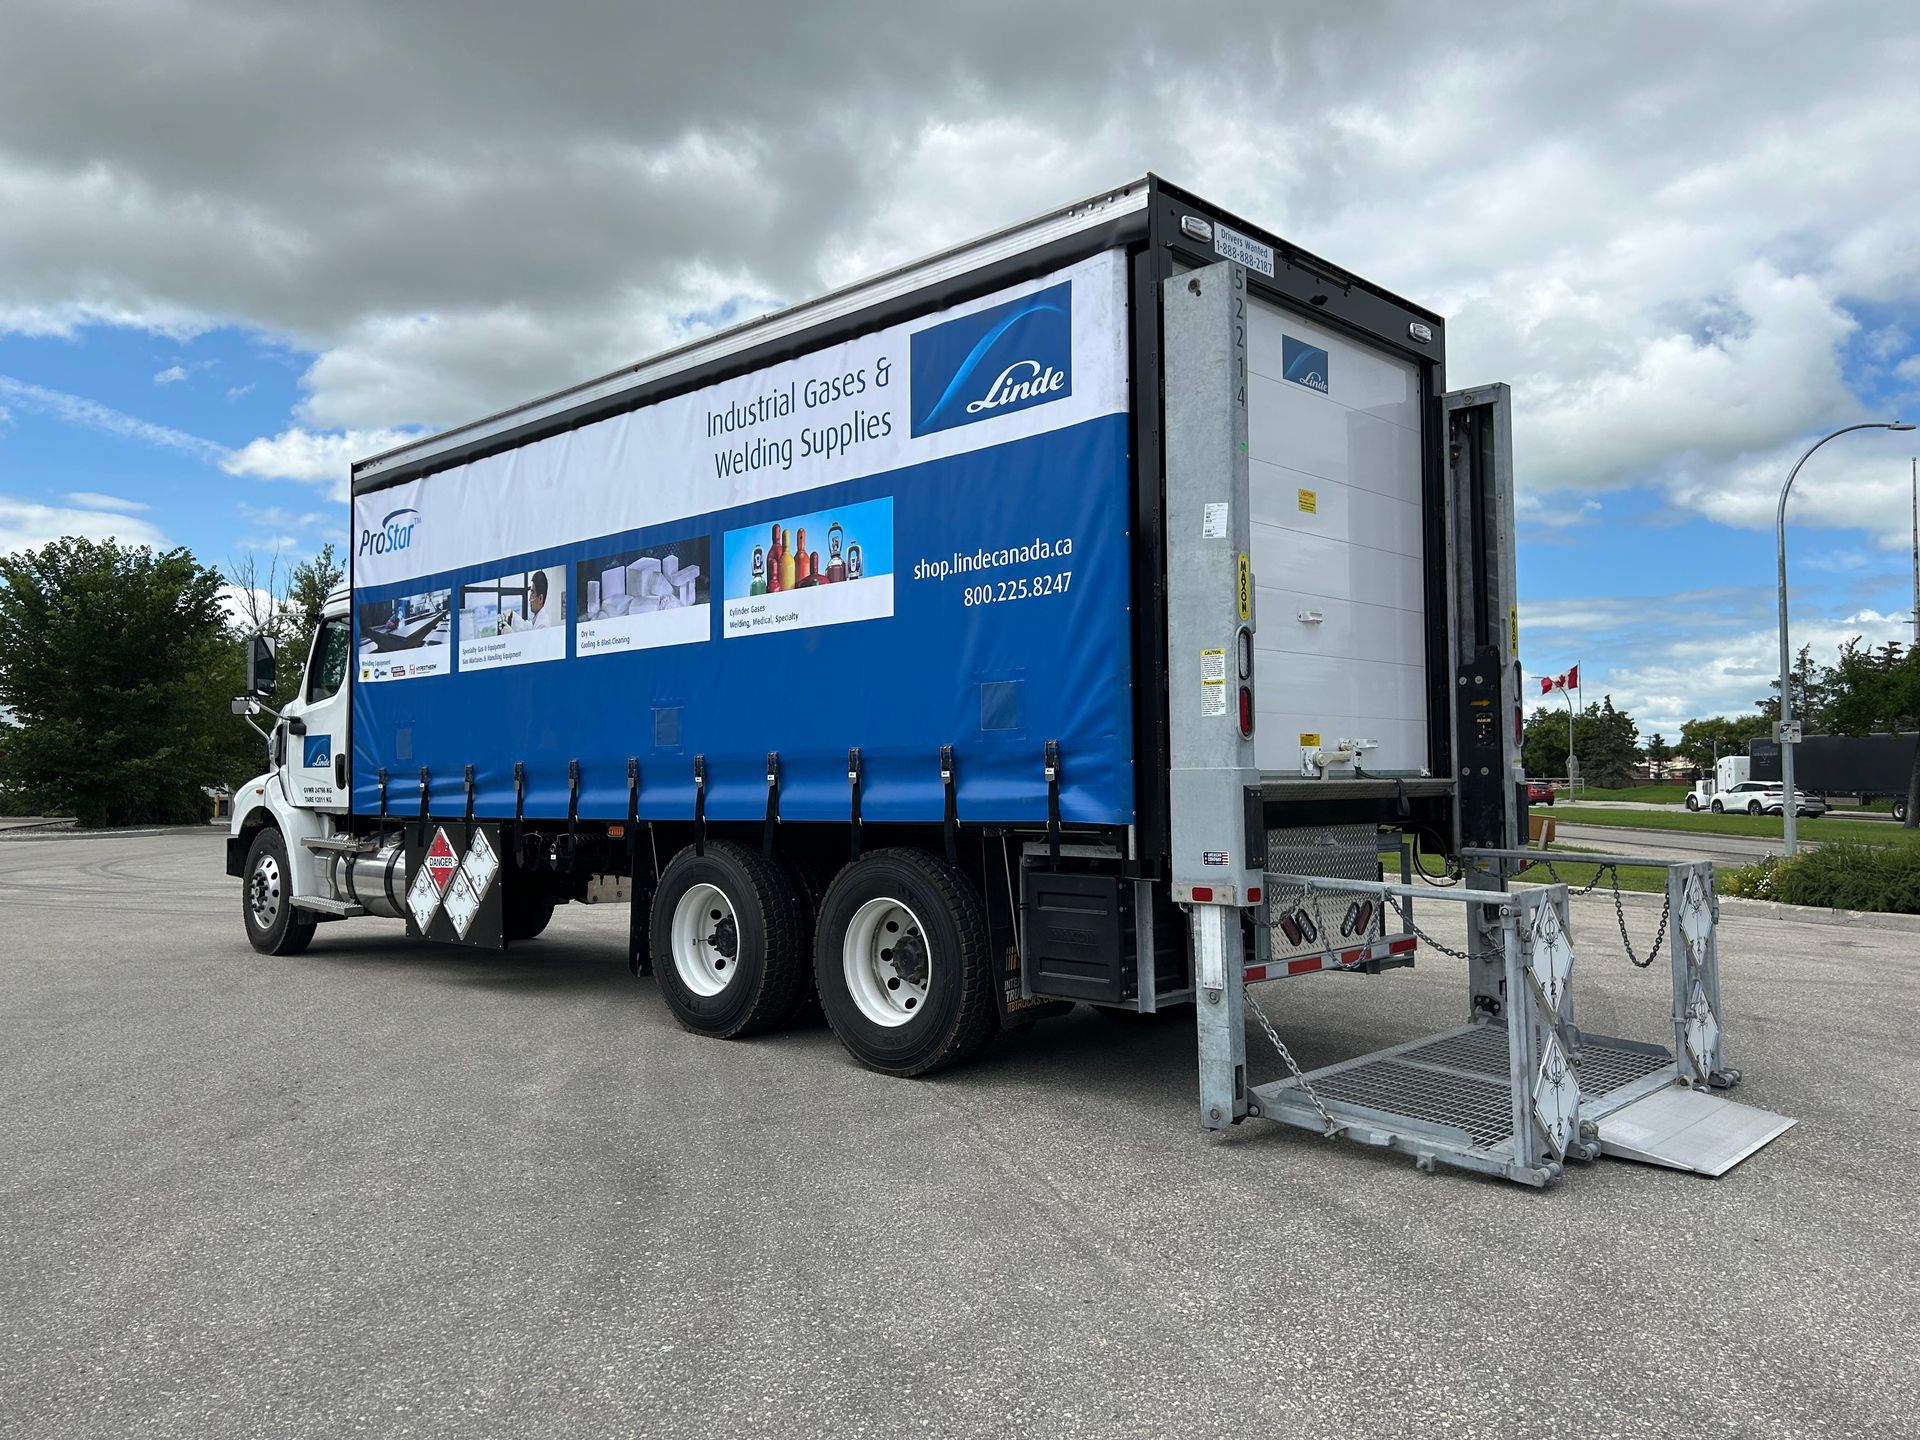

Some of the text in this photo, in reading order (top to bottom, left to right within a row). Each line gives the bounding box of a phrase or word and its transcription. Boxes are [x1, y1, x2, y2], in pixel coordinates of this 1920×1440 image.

[1216, 240, 1272, 274] 1-888-888-2187
[1221, 229, 1268, 259] Drivers Wanted
[707, 356, 892, 437] Industrial Gases &
[966, 360, 1065, 413] Linde
[1300, 371, 1328, 392] Linde
[715, 410, 892, 479] Welding Supplies
[359, 523, 415, 557] ProStar
[913, 537, 1073, 581] shop.lindecanada.ca
[964, 571, 1073, 607] 800.225.8247
[729, 605, 765, 618] Cylinder Gases
[729, 612, 799, 628] Welding, Medical, Specialty
[580, 640, 596, 649] Cooling
[611, 637, 630, 645] Cleaning
[429, 857, 453, 867] DANGER
